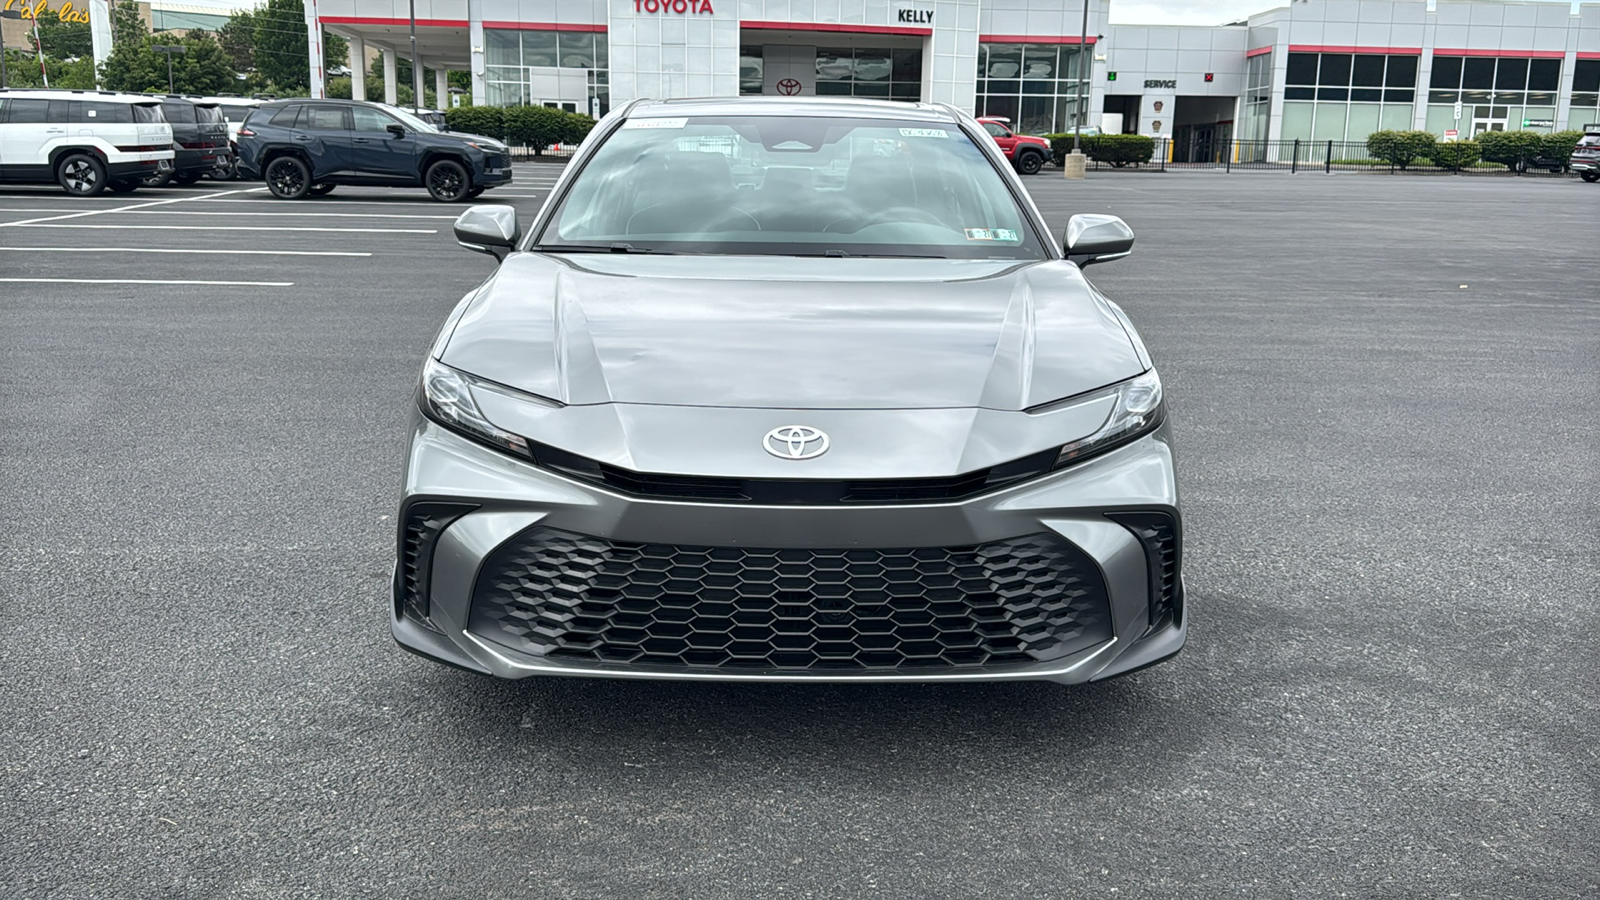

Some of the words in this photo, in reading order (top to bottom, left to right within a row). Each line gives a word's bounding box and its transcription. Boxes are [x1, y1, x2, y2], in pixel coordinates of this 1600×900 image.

[4, 0, 90, 24] abla's
[633, 0, 714, 14] TOYOTA
[898, 9, 934, 23] KELLY
[1143, 79, 1177, 89] SERVICE
